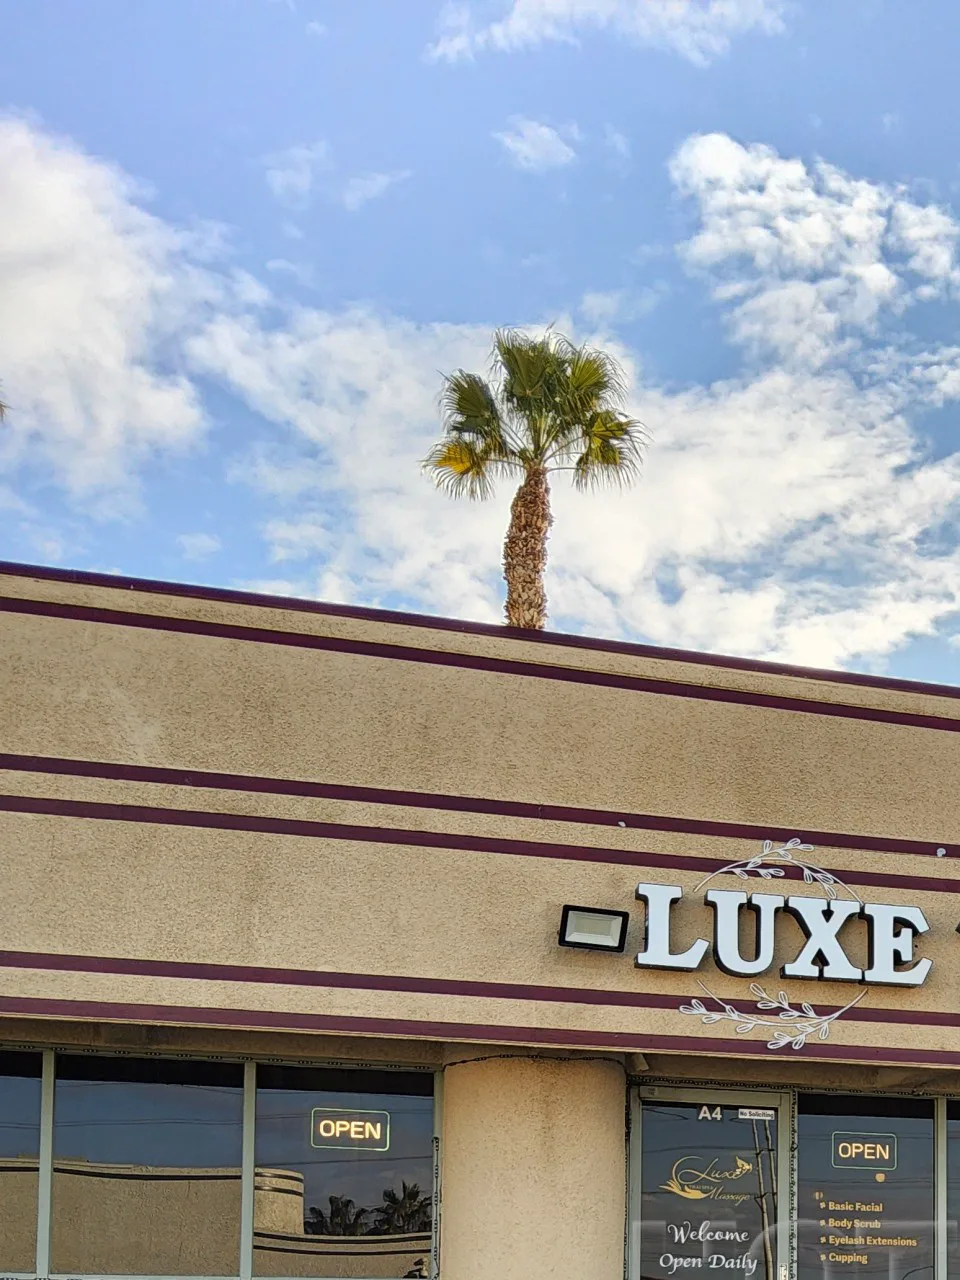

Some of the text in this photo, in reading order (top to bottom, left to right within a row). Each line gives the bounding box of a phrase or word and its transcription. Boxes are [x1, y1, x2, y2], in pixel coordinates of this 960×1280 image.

[634, 883, 933, 988] LUXE
[698, 1105, 722, 1120] A4
[319, 1119, 381, 1140] OPEN
[838, 1142, 890, 1160] OPEN
[673, 1156, 742, 1184] Luxe
[709, 1186, 750, 1206] Massage
[828, 1202, 883, 1212] Basic Facial
[667, 1221, 750, 1244] Welcome
[828, 1218, 881, 1230] Body Scrub
[829, 1236, 917, 1247] Eyelash Extensions
[660, 1252, 758, 1276] Open Daily
[828, 1253, 868, 1264] Cupping
